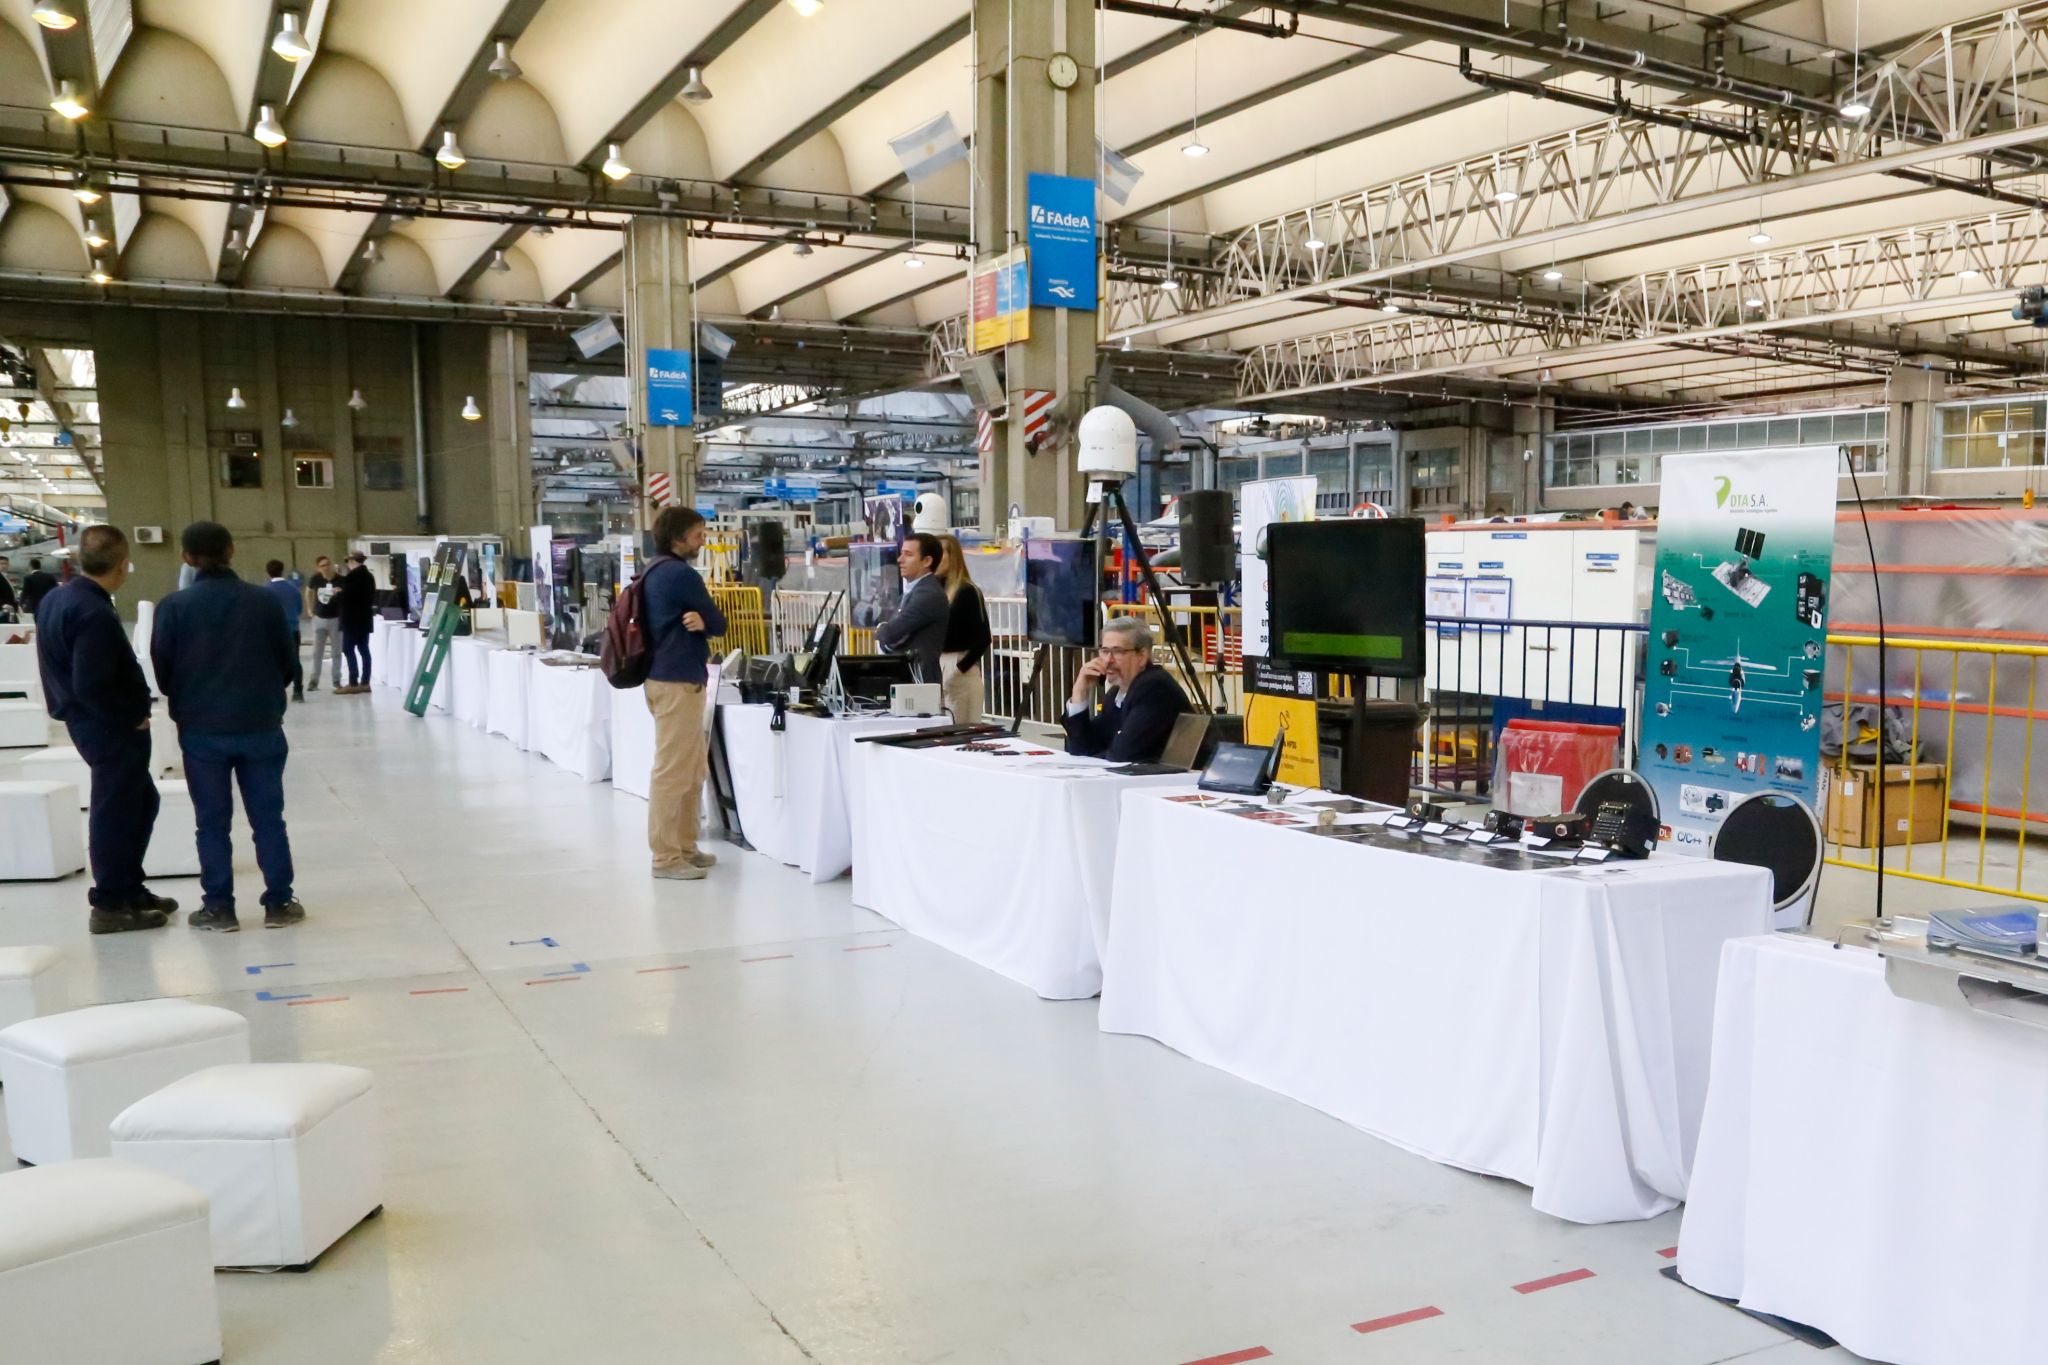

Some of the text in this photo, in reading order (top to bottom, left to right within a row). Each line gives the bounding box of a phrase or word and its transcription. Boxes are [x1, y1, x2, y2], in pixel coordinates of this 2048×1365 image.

[1047, 211, 1090, 229] FAdeA
[1730, 494, 1768, 507] DTA S.A.
